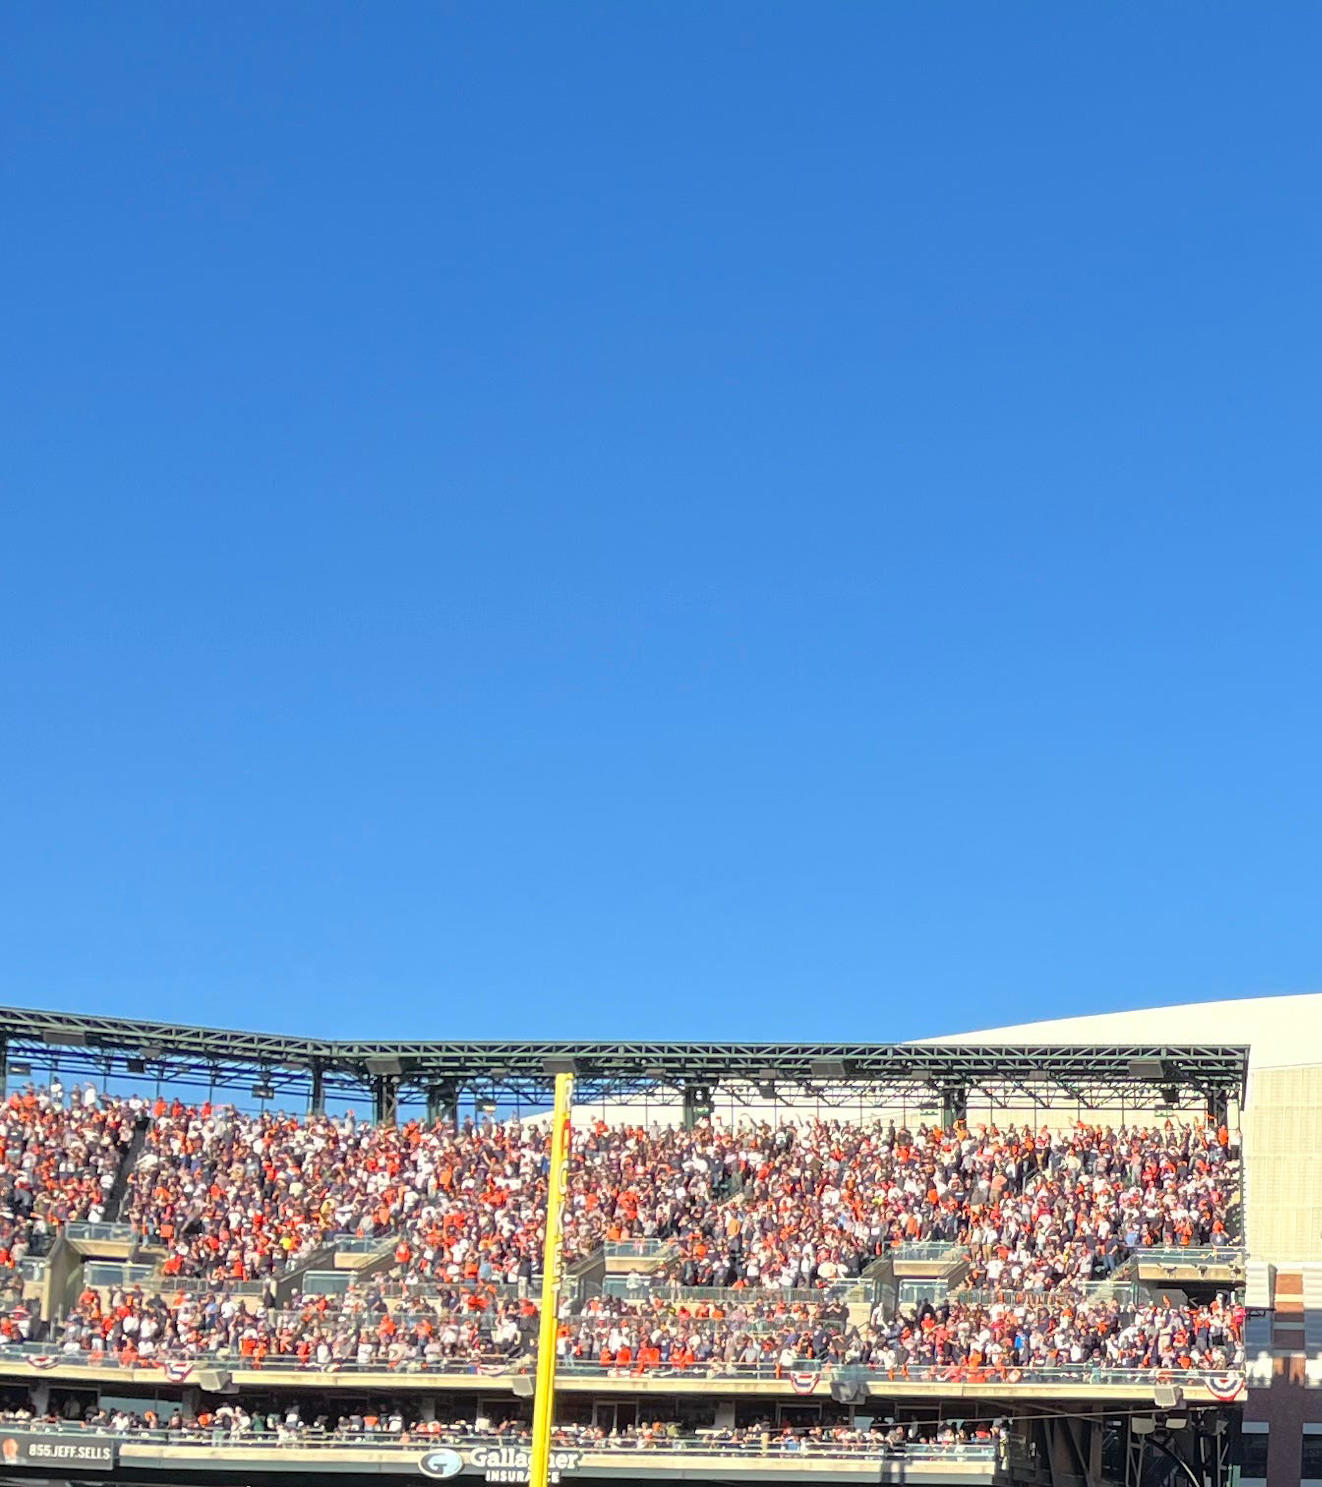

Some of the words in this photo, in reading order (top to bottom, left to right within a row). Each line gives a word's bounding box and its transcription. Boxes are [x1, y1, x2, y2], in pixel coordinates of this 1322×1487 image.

[29, 1444, 111, 1460] 855.JEFF.SELLS
[470, 1447, 579, 1470] Gallaer
[485, 1471, 560, 1483] INSURAE
